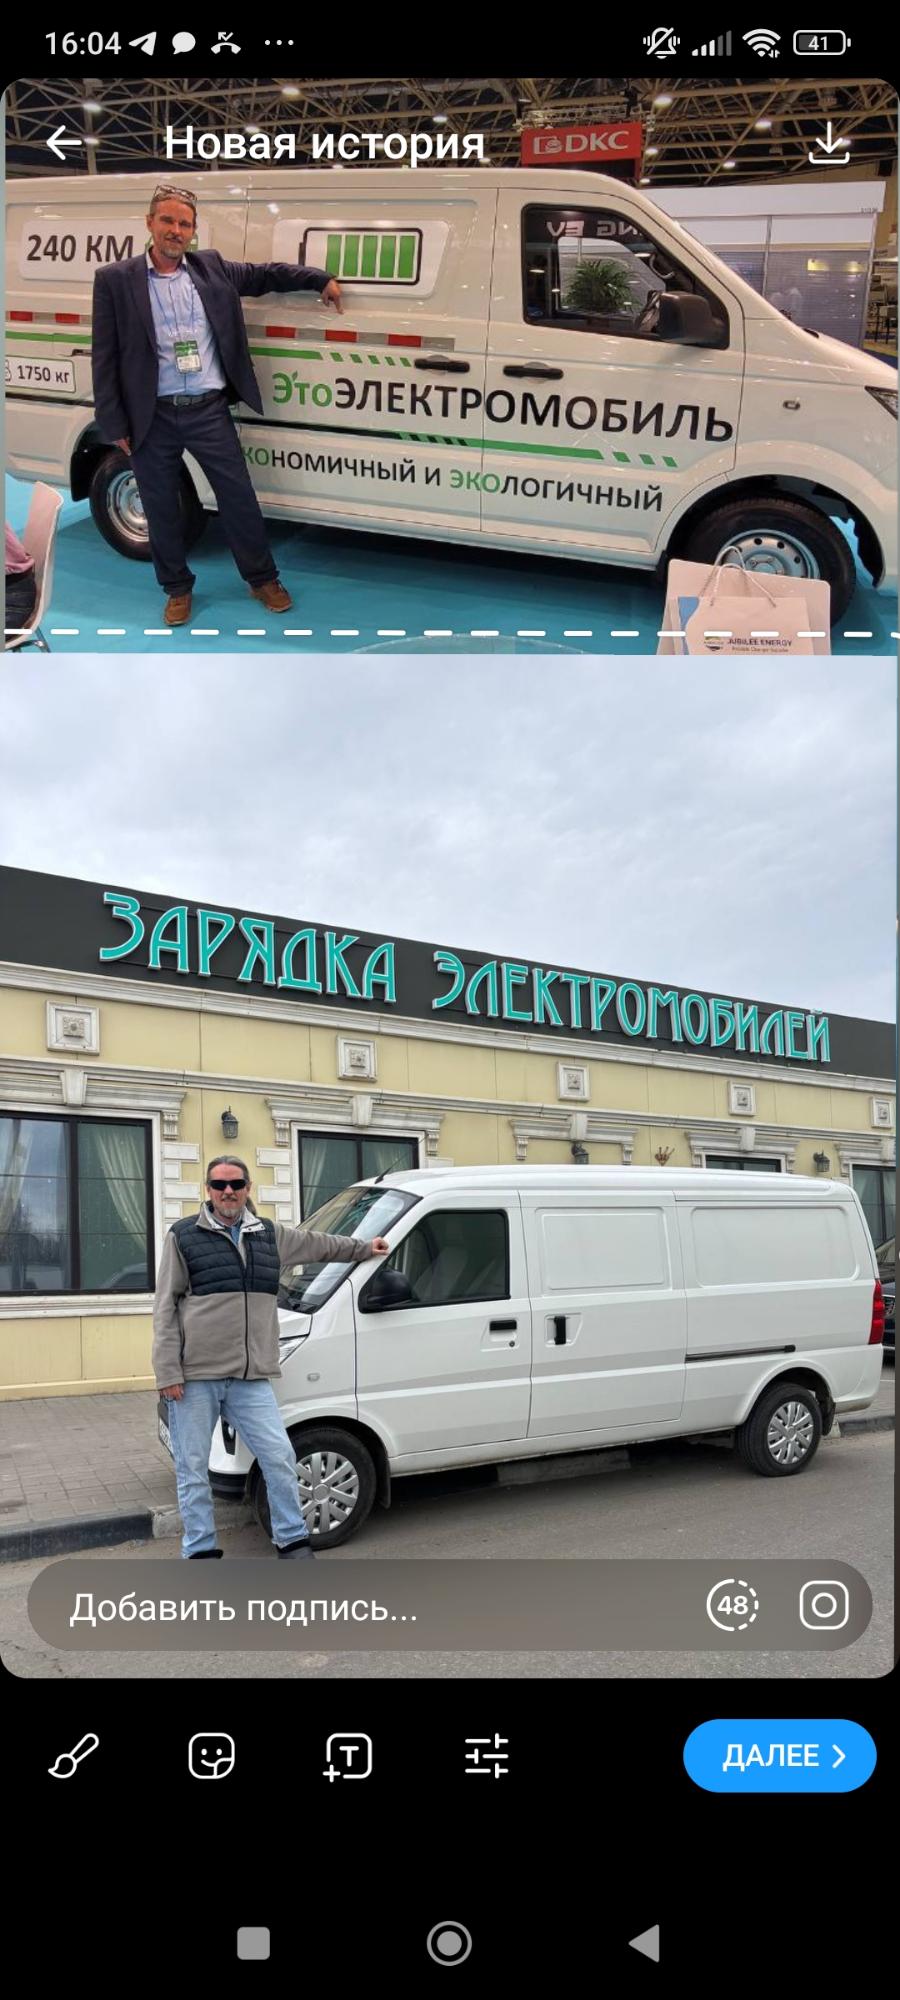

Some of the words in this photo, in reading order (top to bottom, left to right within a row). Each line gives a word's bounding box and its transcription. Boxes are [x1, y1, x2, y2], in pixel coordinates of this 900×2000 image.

[565, 130, 630, 153] DKC
[27, 234, 77, 262] 240
[86, 234, 134, 262] КМ
[17, 364, 52, 382] 1750
[55, 371, 70, 384] кг
[241, 446, 416, 484] КОНОМИЧНЫЙ
[760, 639, 793, 647] ENERGY
[99, 891, 397, 1003] ЗАРЯДКА
[431, 950, 831, 1062] ЭЛЕКТРОМОБИЛЕЙ
